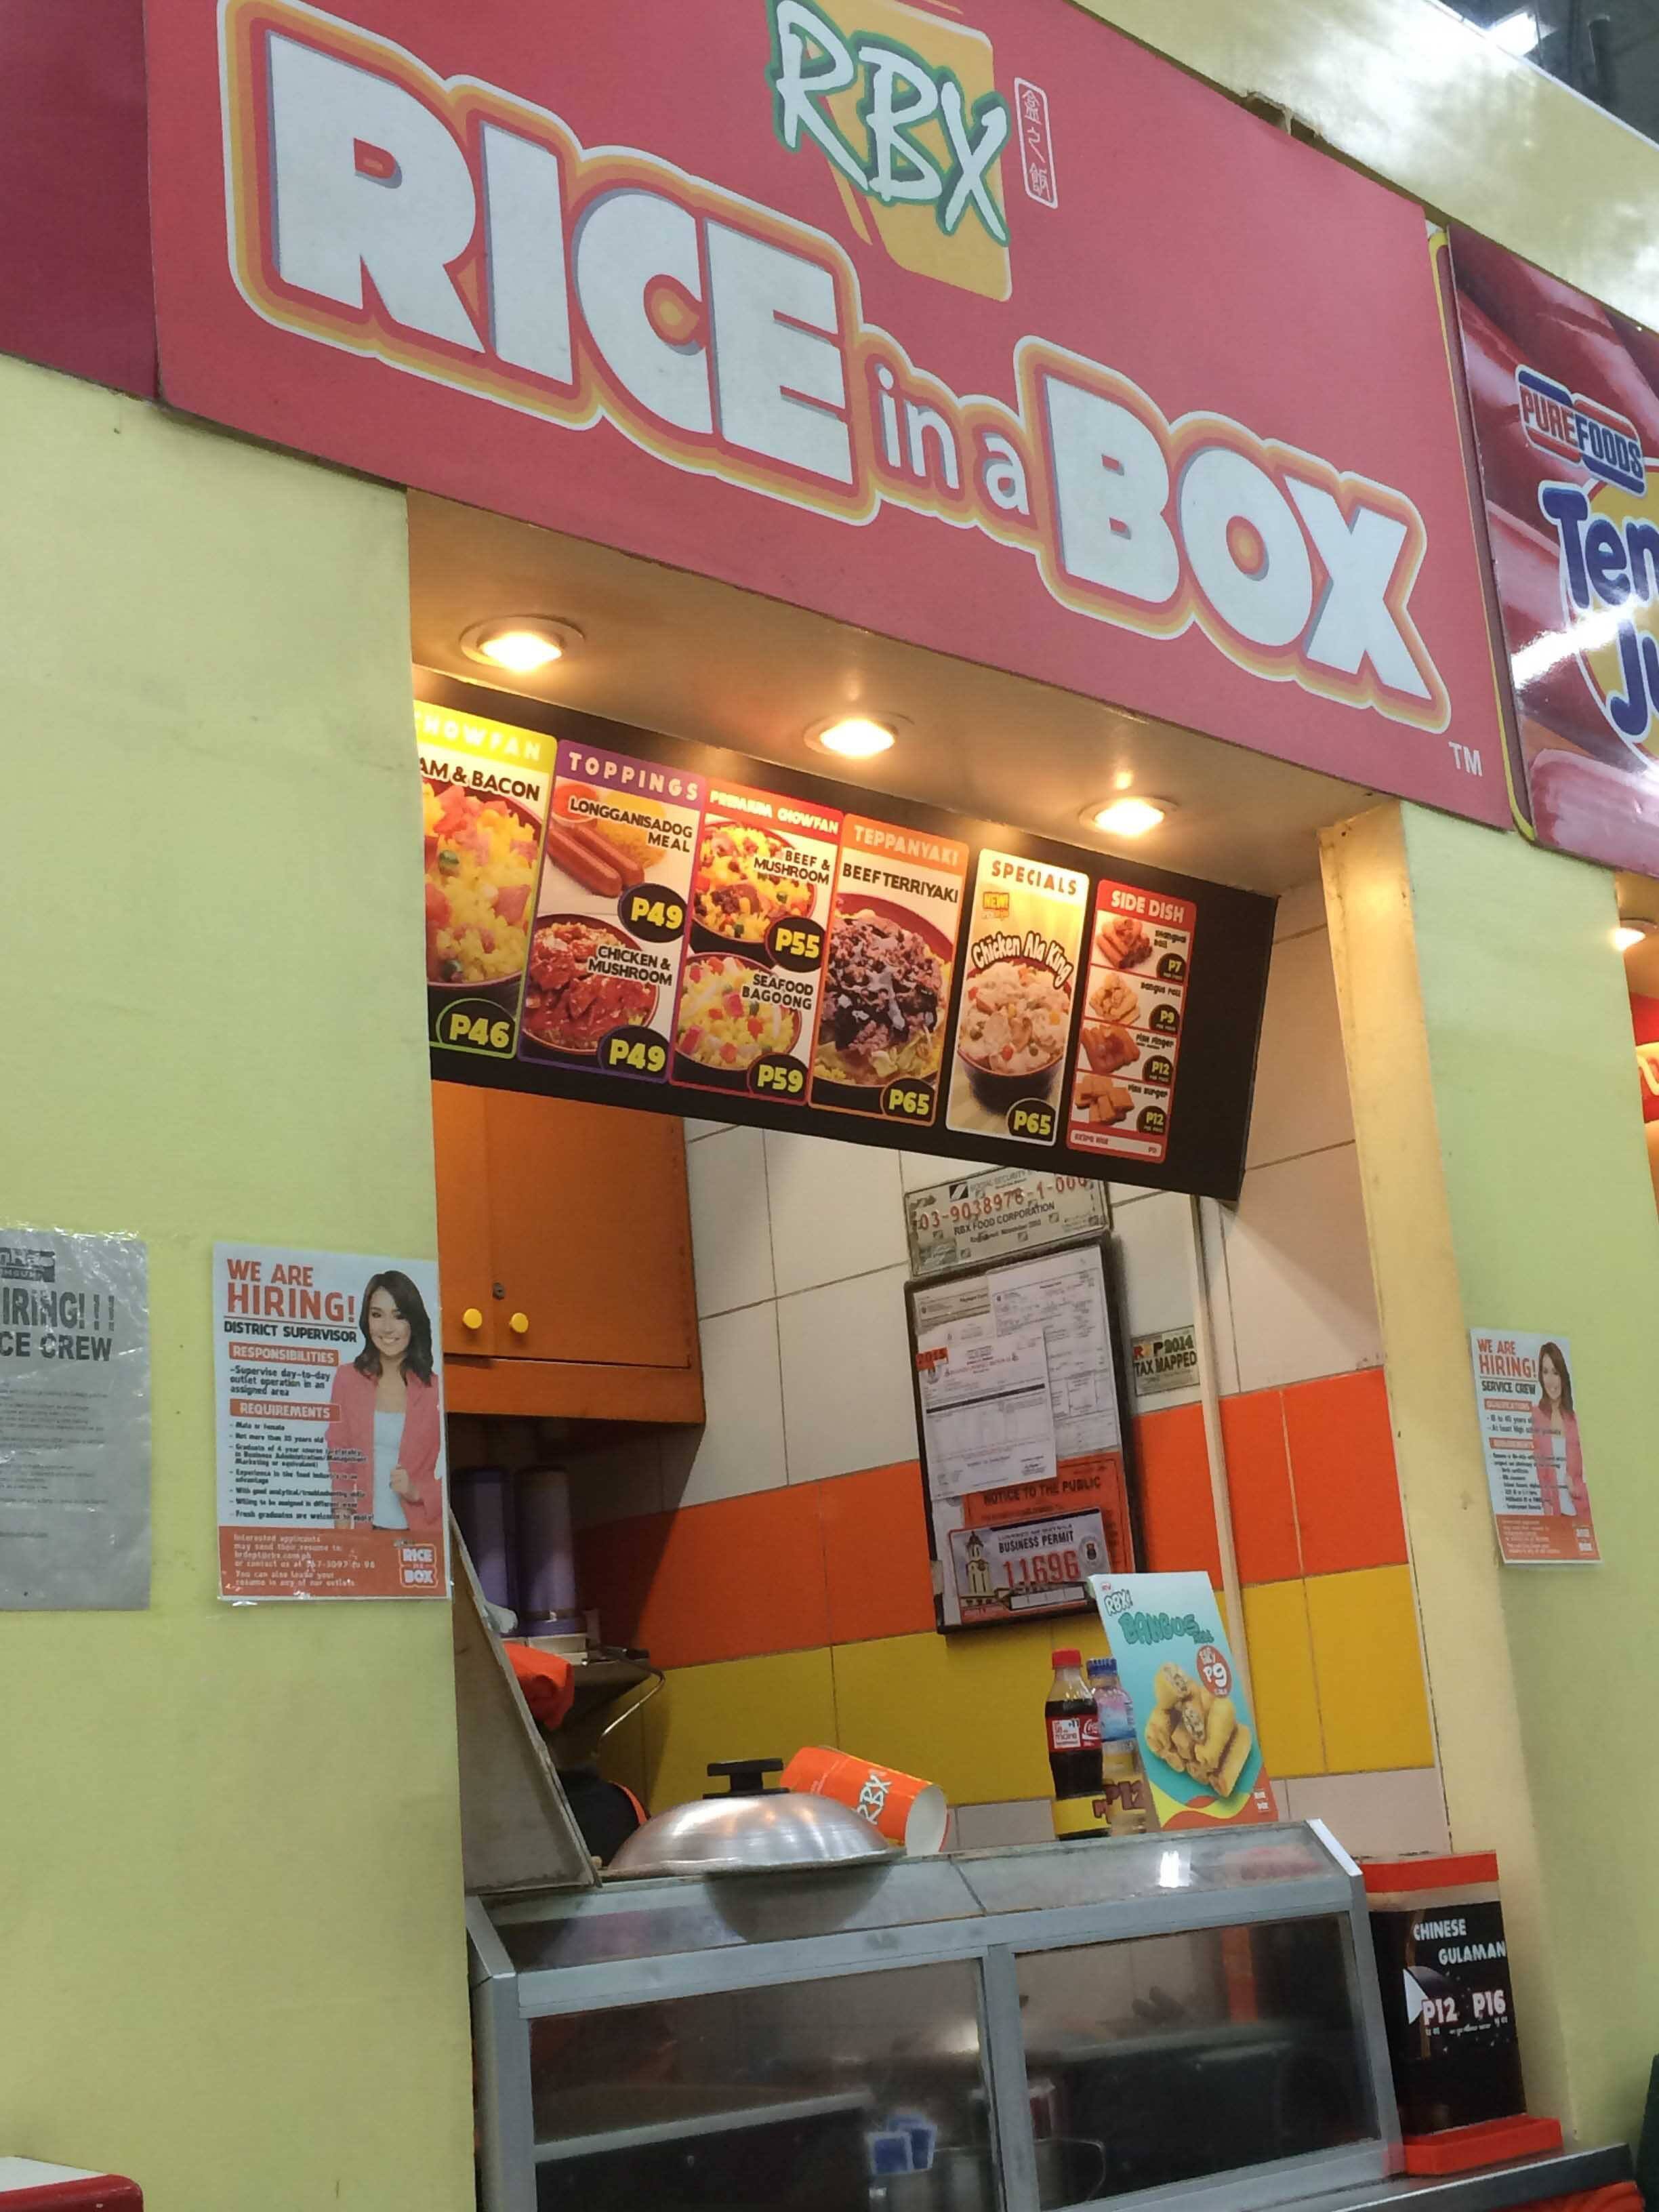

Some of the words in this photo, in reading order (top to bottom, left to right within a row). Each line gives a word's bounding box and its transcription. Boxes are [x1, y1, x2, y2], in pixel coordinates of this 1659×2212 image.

[771, 0, 1010, 245] RBX
[266, 30, 853, 485] RICE
[876, 363, 960, 491] in
[982, 431, 1030, 516] a
[1043, 374, 1432, 700] BOX
[1521, 389, 1643, 480] PUREFOODS
[414, 710, 541, 761] HOWFAN
[453, 766, 467, 783] &
[472, 771, 539, 801] BACON
[569, 752, 699, 801] TOPPINGS
[570, 798, 693, 838] LONGGANISADOG
[648, 832, 690, 853] MEAL
[854, 825, 959, 866] TEPPANYAKI
[754, 857, 829, 885] MUSHROOM
[785, 850, 817, 866] BEEF
[821, 859, 830, 871] &
[842, 863, 880, 883] BEEF
[882, 872, 958, 903] TERRIYAKI
[991, 860, 1077, 895] SPECIALS
[630, 897, 683, 929] P49
[1111, 890, 1145, 914] SIDE
[1148, 899, 1185, 923] DISH
[598, 945, 658, 967] CHICKEN
[660, 958, 670, 970] &
[775, 928, 820, 959] P55
[588, 960, 672, 986] MUSHROOM
[972, 931, 1021, 969] Chicken
[1045, 941, 1074, 987] King
[742, 986, 812, 1010] BAGOONG
[753, 973, 813, 996] SEAFOOD
[449, 1013, 510, 1048] P46
[609, 1039, 666, 1072] P49
[1152, 1061, 1170, 1075] P12
[757, 1065, 804, 1093] P59
[888, 1088, 930, 1115] P65
[1013, 1110, 1051, 1135] P65
[1146, 1111, 1164, 1125] P12
[954, 1222, 971, 1236] RBX
[972, 1215, 995, 1231] FOOD
[996, 1201, 1055, 1225] CORPORATION
[227, 1258, 262, 1282] WE
[271, 1263, 314, 1288] ARE
[227, 1282, 355, 1323] HIRING!
[224, 1321, 277, 1337] DISTRICT
[283, 1326, 357, 1343] SUPERVISOR
[40, 1332, 112, 1361] CREW
[232, 1346, 335, 1364] RESPONSIBILITIES
[1477, 1338, 1493, 1353] WE
[1497, 1340, 1516, 1355] ARE
[1133, 1359, 1154, 1378] TAX
[1155, 1350, 1197, 1373] MAPPED
[1479, 1354, 1537, 1378] HIRING!
[1481, 1380, 1513, 1393] SERVICE
[1515, 1382, 1536, 1395] CREW
[240, 1403, 331, 1419] REQUIREMENTS
[1063, 1477, 1101, 1492] PUBLIC
[998, 1536, 1039, 1553] BUSINESS
[1042, 1530, 1074, 1546] PERMIT
[1003, 1549, 1081, 1589] 11696
[1203, 1662, 1227, 1688] P9
[1413, 1918, 1467, 1942] CHINESE
[1438, 1941, 1507, 1966] GULAMAN
[1422, 1997, 1458, 2027] P12
[1473, 1989, 1507, 2017] P16
